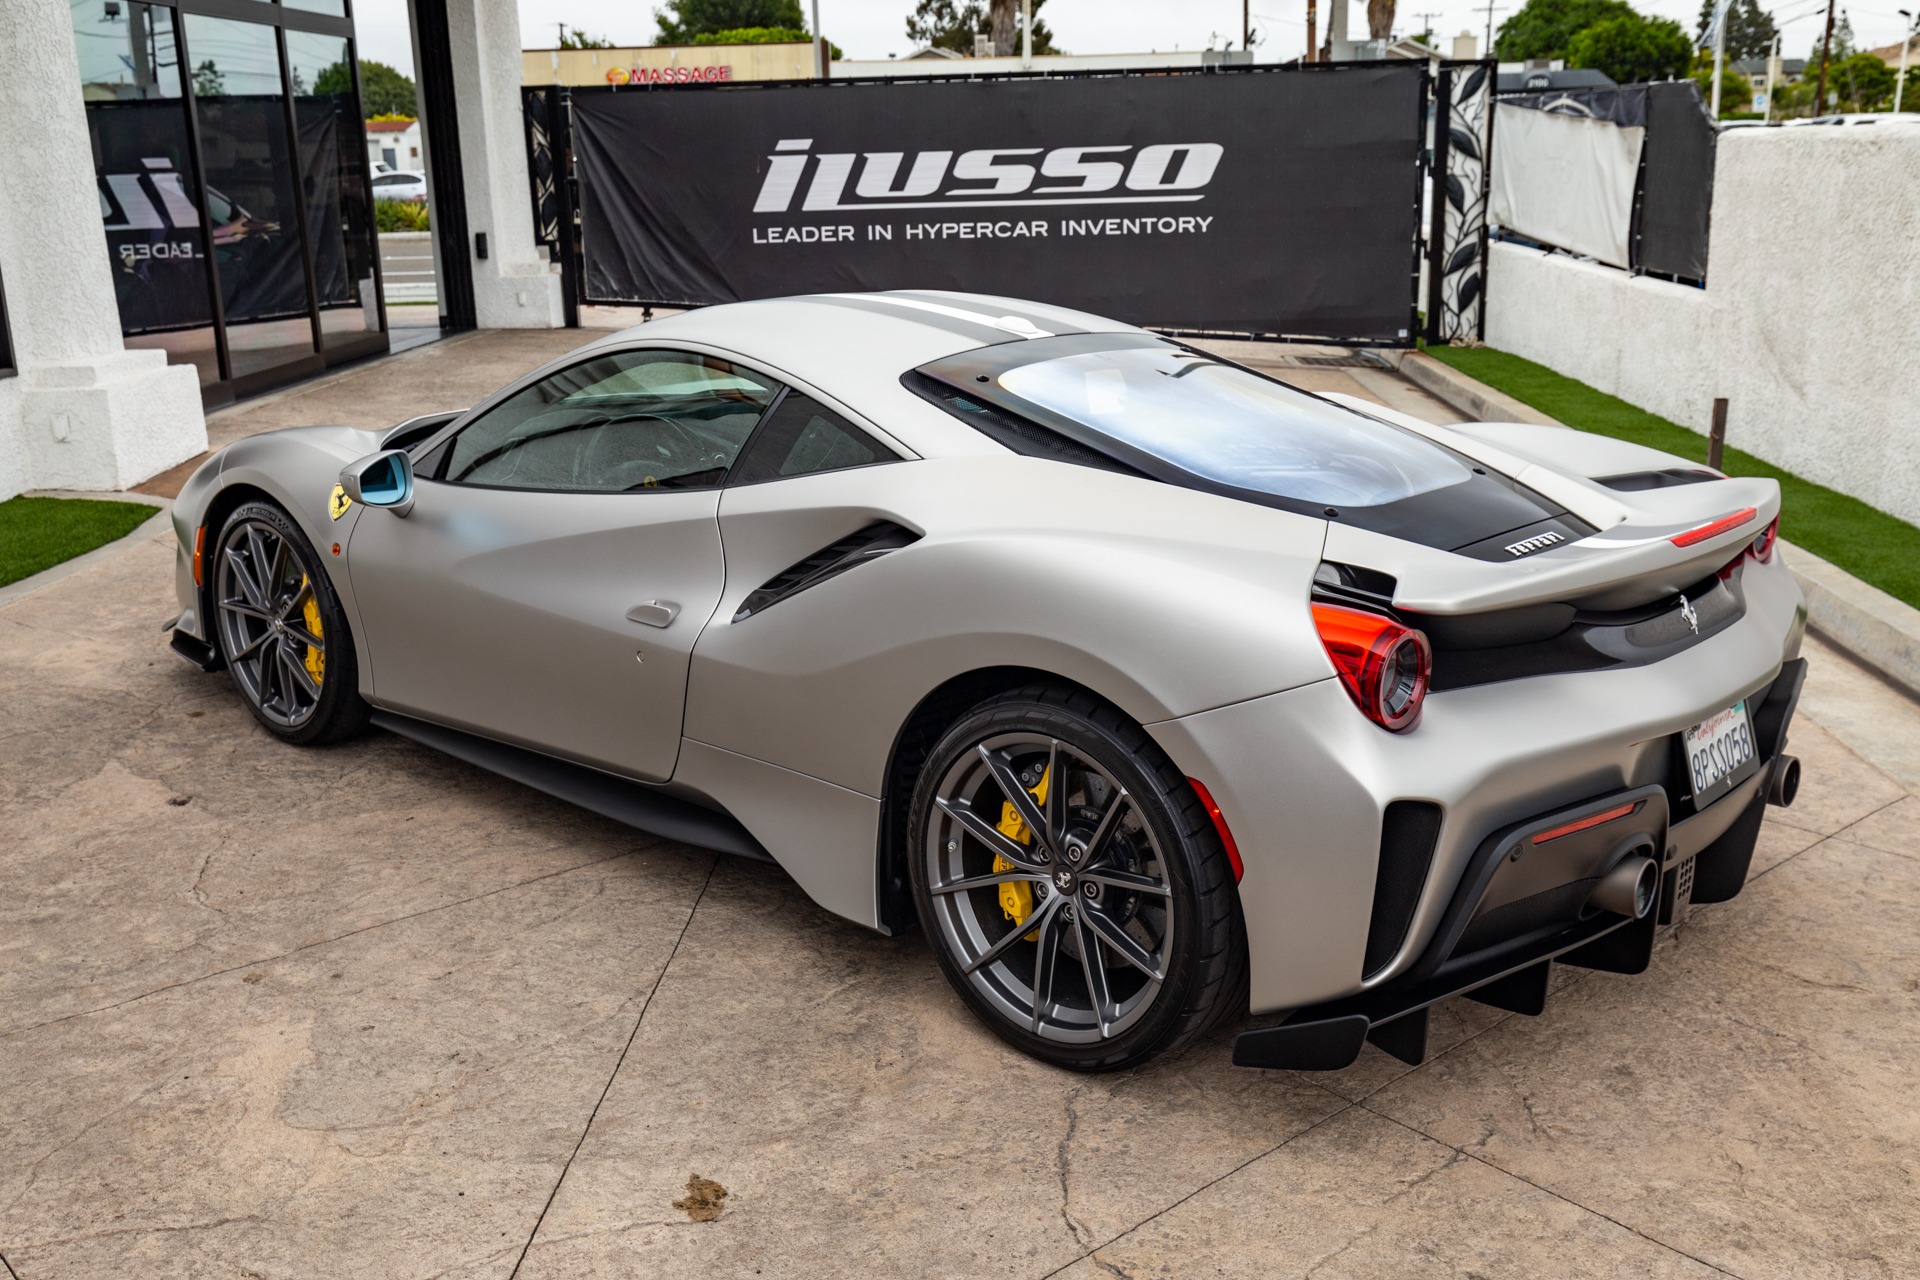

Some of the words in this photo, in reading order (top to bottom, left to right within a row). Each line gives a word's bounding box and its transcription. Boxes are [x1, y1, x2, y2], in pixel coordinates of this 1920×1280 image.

[631, 65, 731, 84] MASSAGE
[752, 225, 855, 244] LEADER
[867, 224, 893, 241] IN
[905, 220, 1049, 240] HYPERCAR
[1060, 216, 1213, 237] INVENTORY
[1504, 531, 1565, 557] Ferrari
[1692, 722, 1751, 792] 8PSS058
